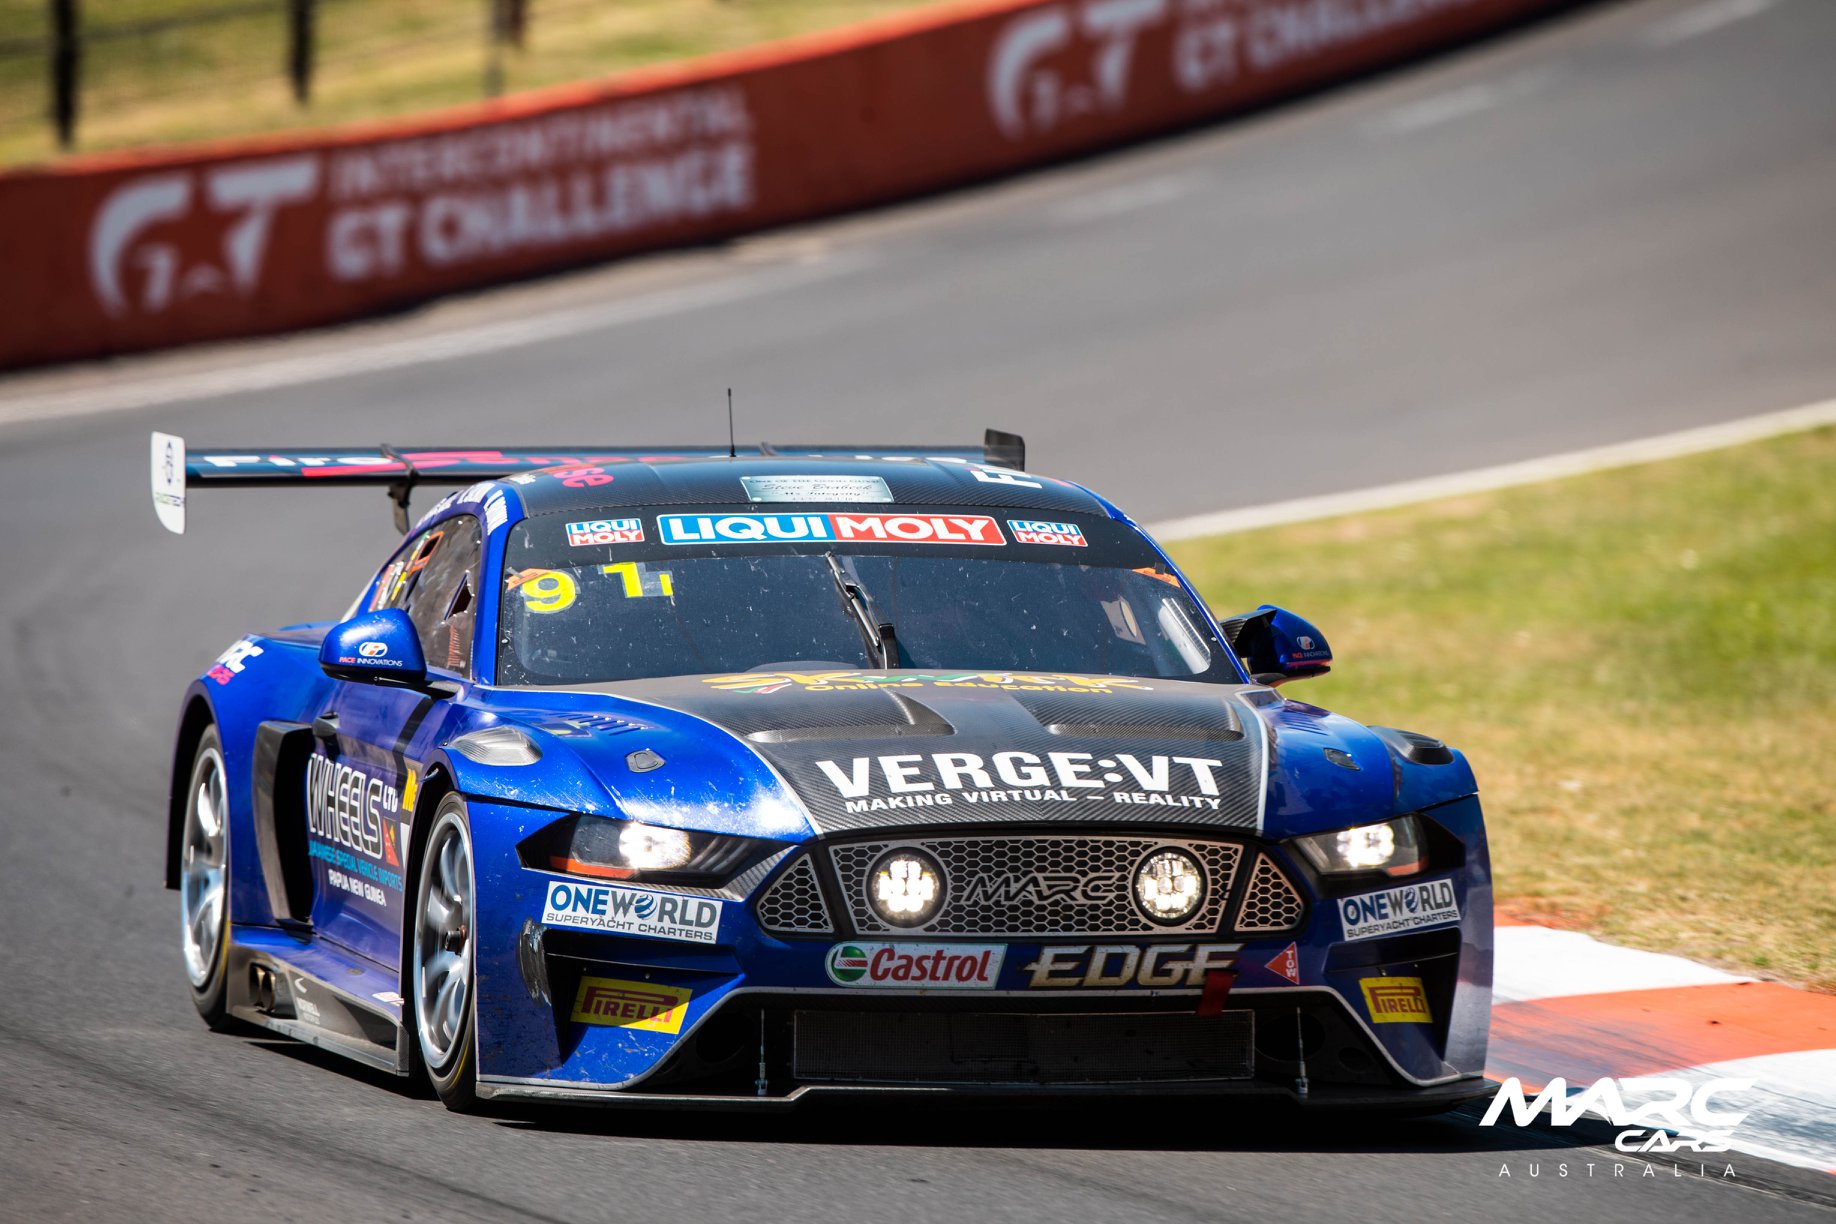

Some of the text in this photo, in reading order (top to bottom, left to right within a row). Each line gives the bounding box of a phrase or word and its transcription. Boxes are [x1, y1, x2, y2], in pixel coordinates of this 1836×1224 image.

[326, 144, 750, 279] GT CHALLENGE
[569, 519, 638, 534] LIQUI
[572, 530, 640, 545] MOLY
[669, 516, 989, 542] LIQUI MOLY
[1012, 521, 1078, 535] LIQUI
[1017, 531, 1082, 545] MOLY
[357, 657, 403, 667] INNOVATIONS
[804, 682, 1114, 694] Online Education
[815, 751, 1223, 798] VERGE:VT
[383, 785, 398, 813] LTD
[845, 792, 952, 813] MAKING
[962, 789, 1077, 804] VIRTUAL
[1114, 791, 1222, 811] REALITY
[960, 873, 1122, 904] MARC
[546, 912, 714, 941] SUPERYACHT CHARTERS
[1346, 909, 1459, 938] SUPERYACHT CHARTERS
[870, 948, 992, 982] Castrol
[1024, 944, 1246, 987] EDGE
[581, 986, 679, 1024] PIRELLI
[1367, 986, 1428, 1014] PIRELLI
